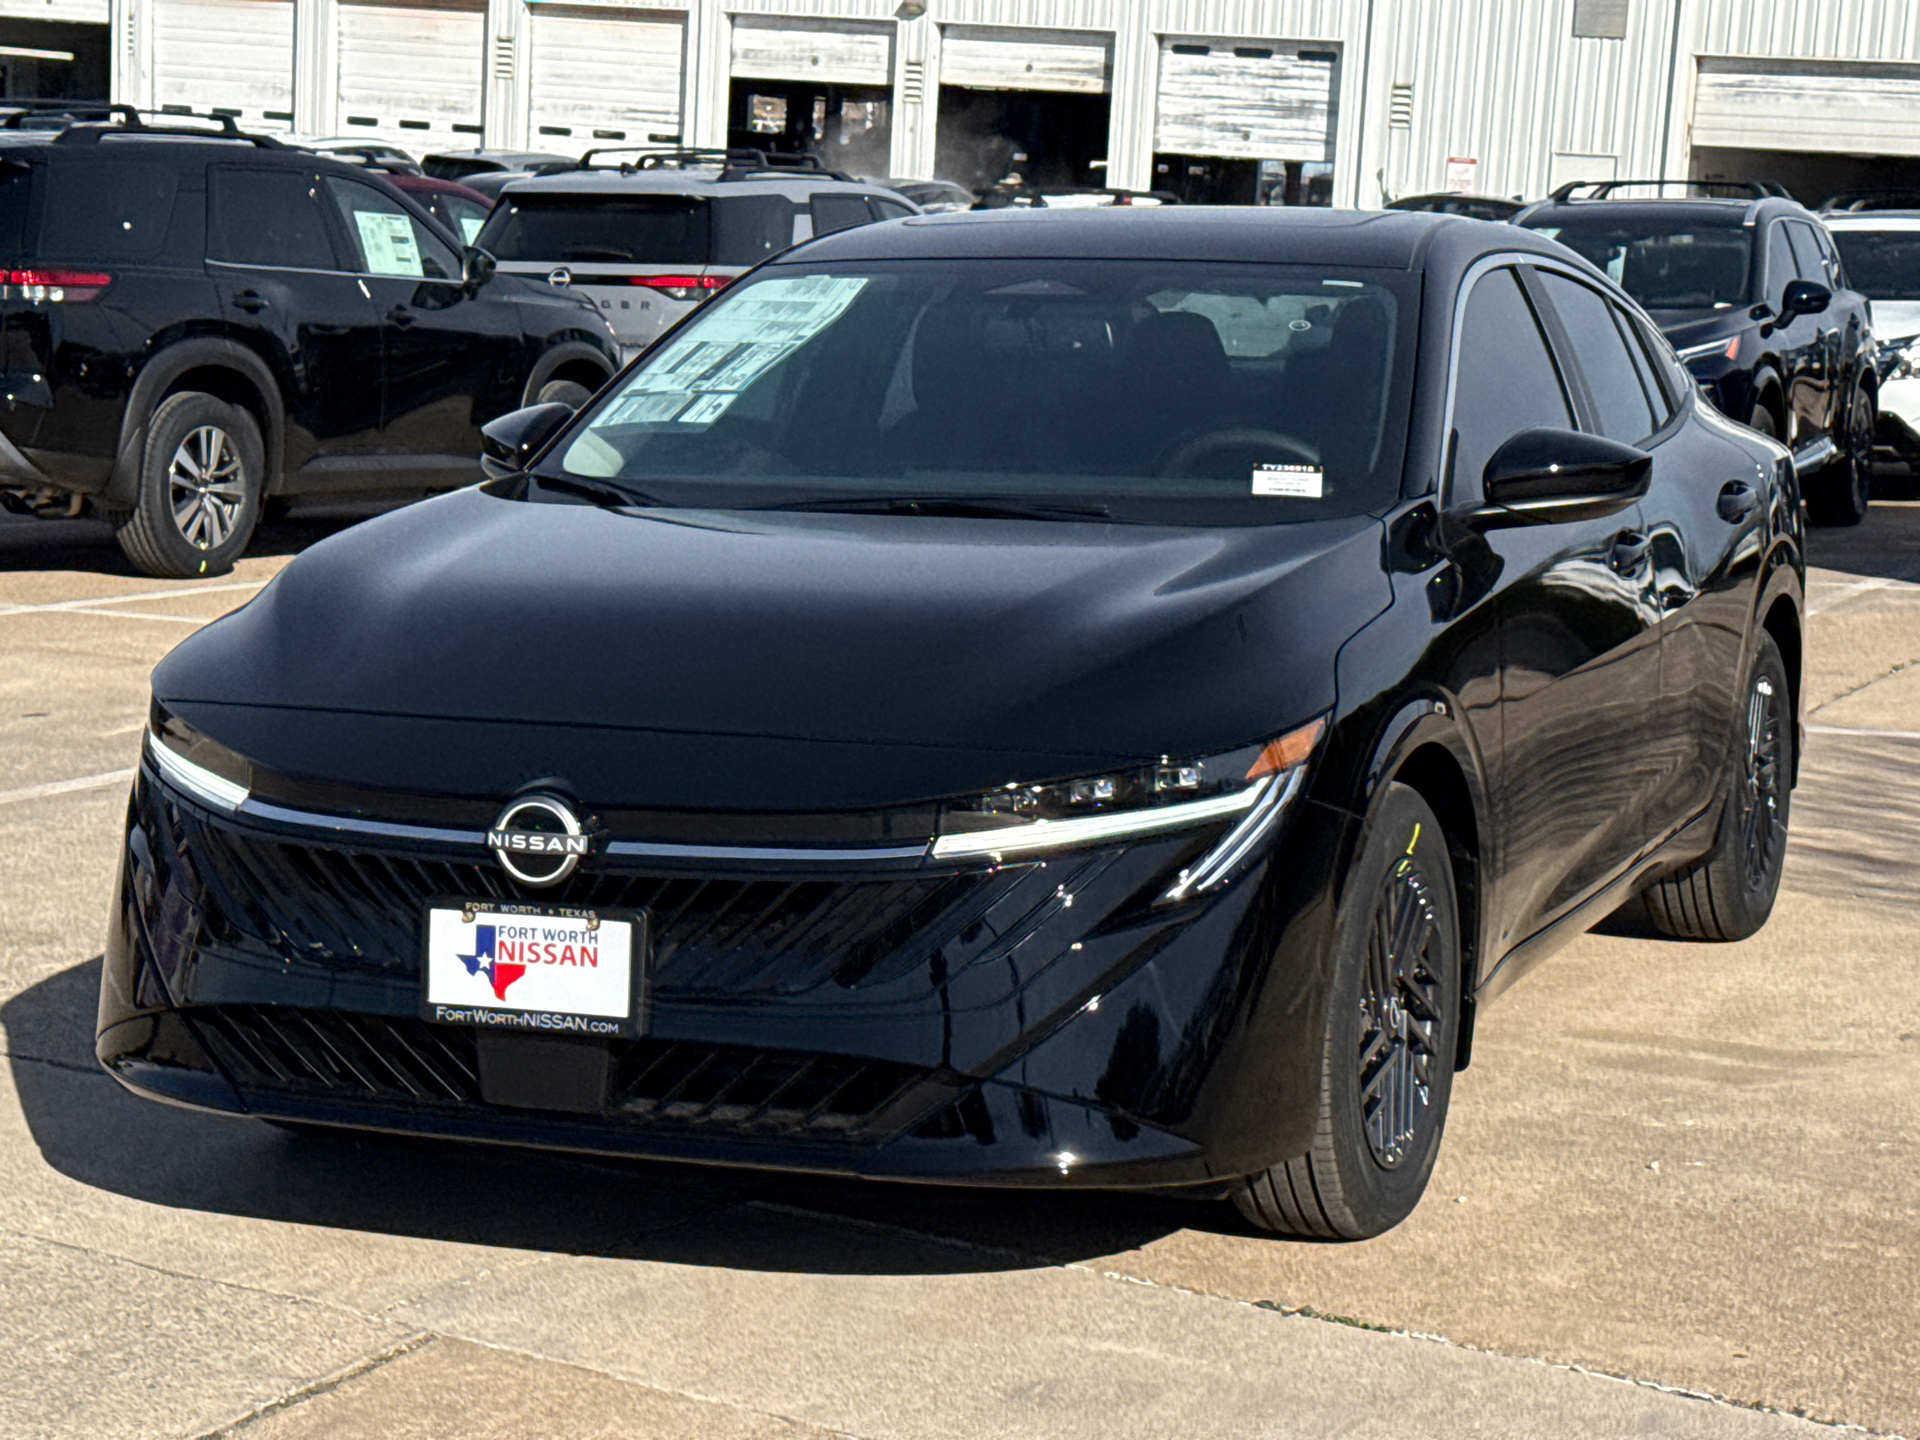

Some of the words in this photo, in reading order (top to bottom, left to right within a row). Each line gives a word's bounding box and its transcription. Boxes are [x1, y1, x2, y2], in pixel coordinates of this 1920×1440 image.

[488, 832, 584, 852] NISSAN
[465, 902, 495, 912] FORT
[500, 904, 541, 914] WORTH
[559, 907, 596, 918] TEXAS
[499, 925, 538, 940] FORT
[543, 928, 598, 945] WORTH
[498, 940, 598, 968] NISSAN
